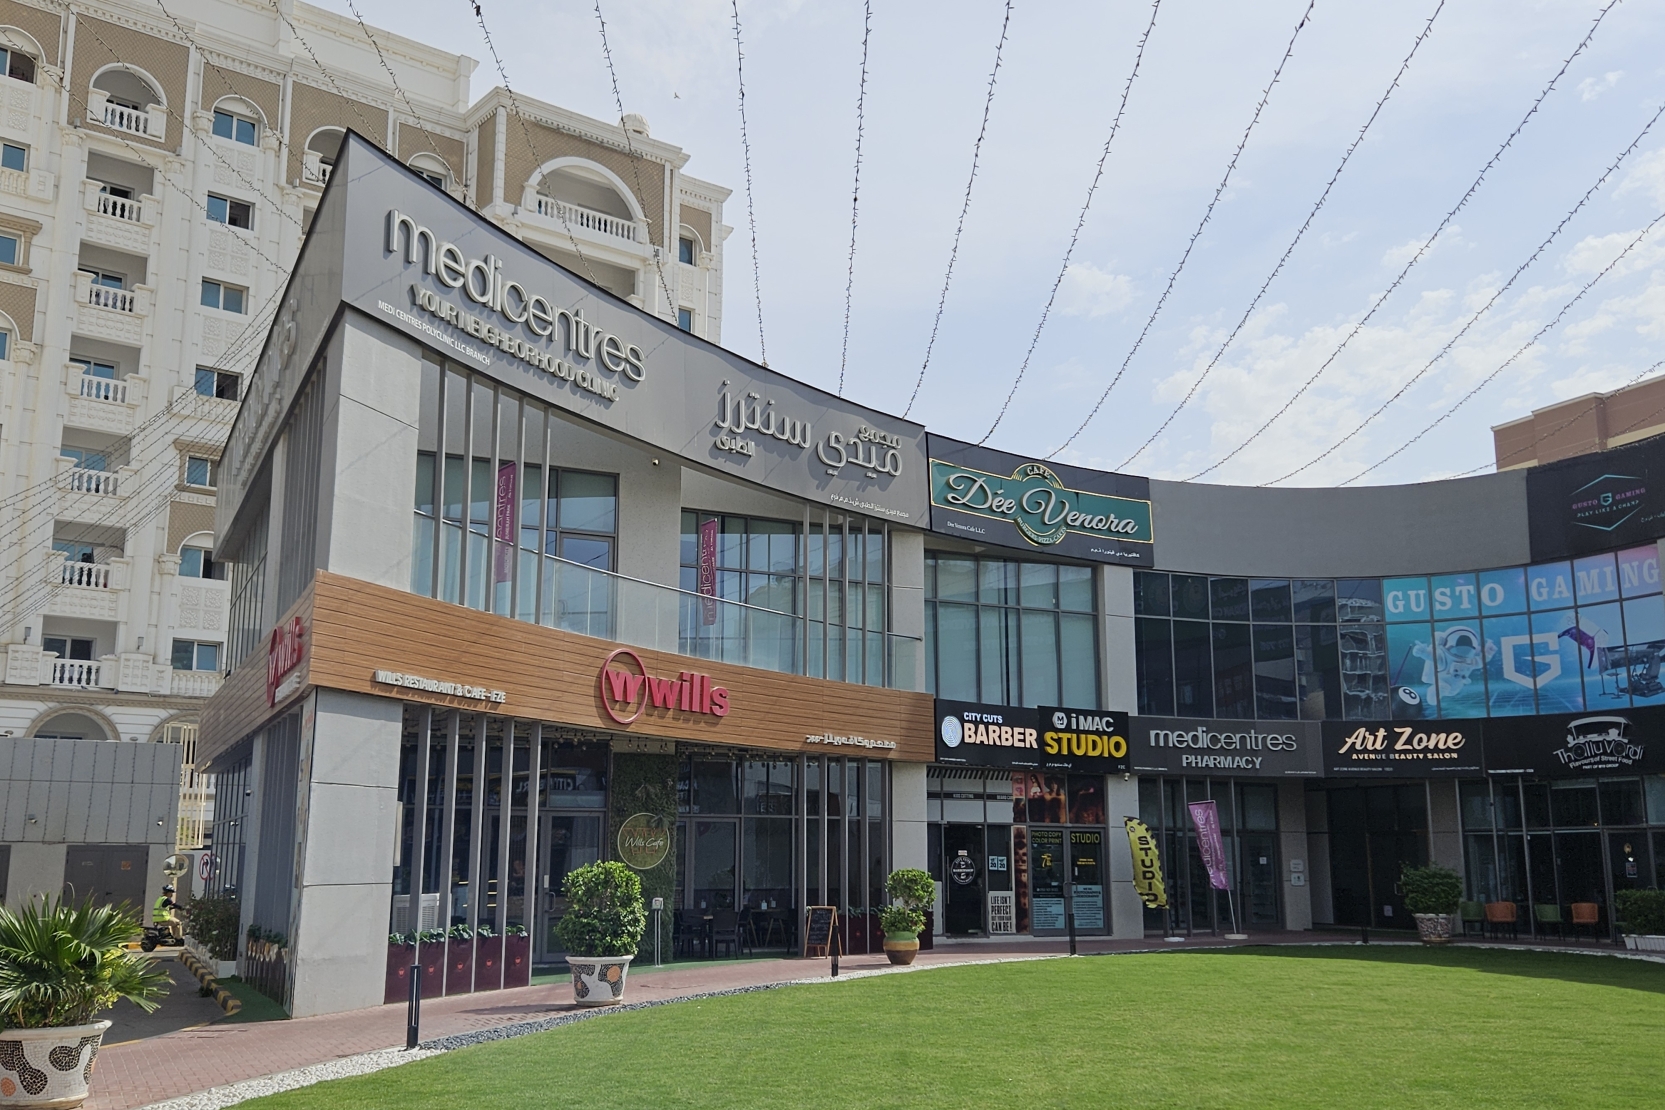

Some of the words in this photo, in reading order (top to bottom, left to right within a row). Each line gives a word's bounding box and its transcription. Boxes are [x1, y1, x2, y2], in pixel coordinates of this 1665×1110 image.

[388, 208, 646, 382] medicentres
[378, 300, 395, 315] MEDI
[396, 309, 422, 330] CENTRES
[422, 323, 455, 347] POLYCLINIC
[455, 340, 466, 353] LLC
[465, 346, 491, 366] BRANCH
[412, 283, 457, 325] YOUR
[457, 310, 575, 382] NEIGHBORHOOD
[576, 369, 620, 401] CLINIC
[1022, 487, 1139, 534] Venora
[1572, 499, 1598, 510] GUSTO
[1615, 487, 1646, 500] GAMING
[1386, 582, 1505, 614] GUSTO
[1531, 557, 1660, 602] GAMING
[403, 674, 456, 695] RESTAURANT
[456, 685, 463, 696] &
[463, 685, 486, 700] CAFE
[647, 671, 729, 717] wills
[964, 712, 982, 722] CITY
[983, 713, 1003, 724] CUTS
[1079, 716, 1114, 732] MAC
[964, 722, 1039, 749] BARBER
[1043, 731, 1127, 758] STUDIO
[1150, 726, 1297, 751] medicentres
[1338, 727, 1388, 754] Art
[1393, 727, 1466, 751] Zone
[1182, 754, 1263, 769] PHARMACY
[1071, 833, 1100, 843] STUDIO
[1138, 836, 1158, 902] STUDIO
[991, 896, 999, 904] LIFE
[991, 905, 1011, 915] PERFECT
[991, 921, 1002, 932] CAN
